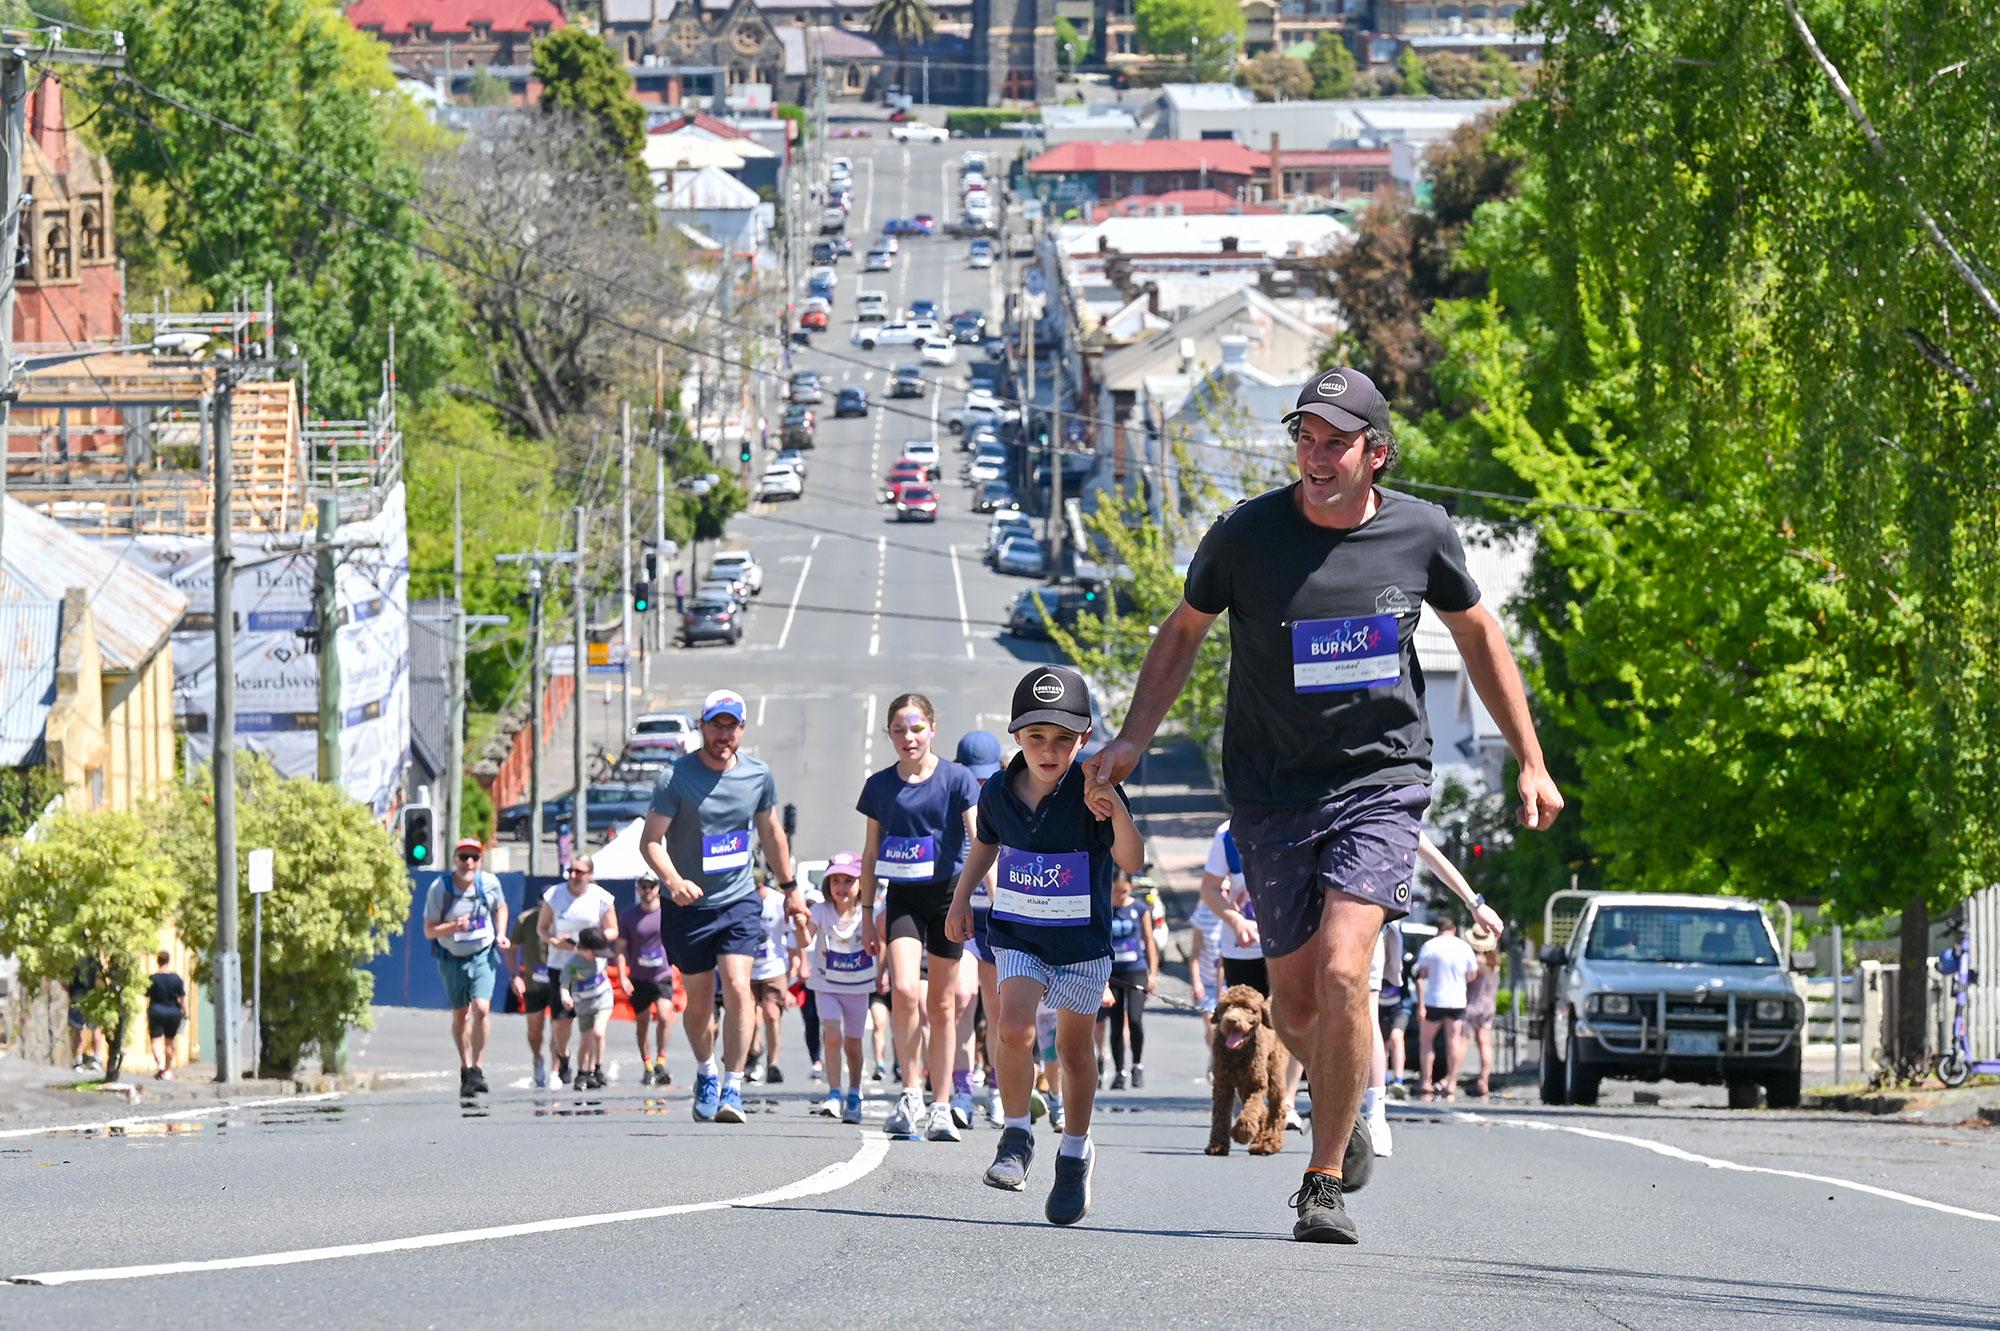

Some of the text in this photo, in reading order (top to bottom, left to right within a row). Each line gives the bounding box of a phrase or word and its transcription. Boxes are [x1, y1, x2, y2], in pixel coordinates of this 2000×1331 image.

[1311, 641, 1352, 655] BURN
[235, 671, 320, 690] eardwo
[886, 849, 909, 860] BURN
[1009, 870, 1044, 888] BURN
